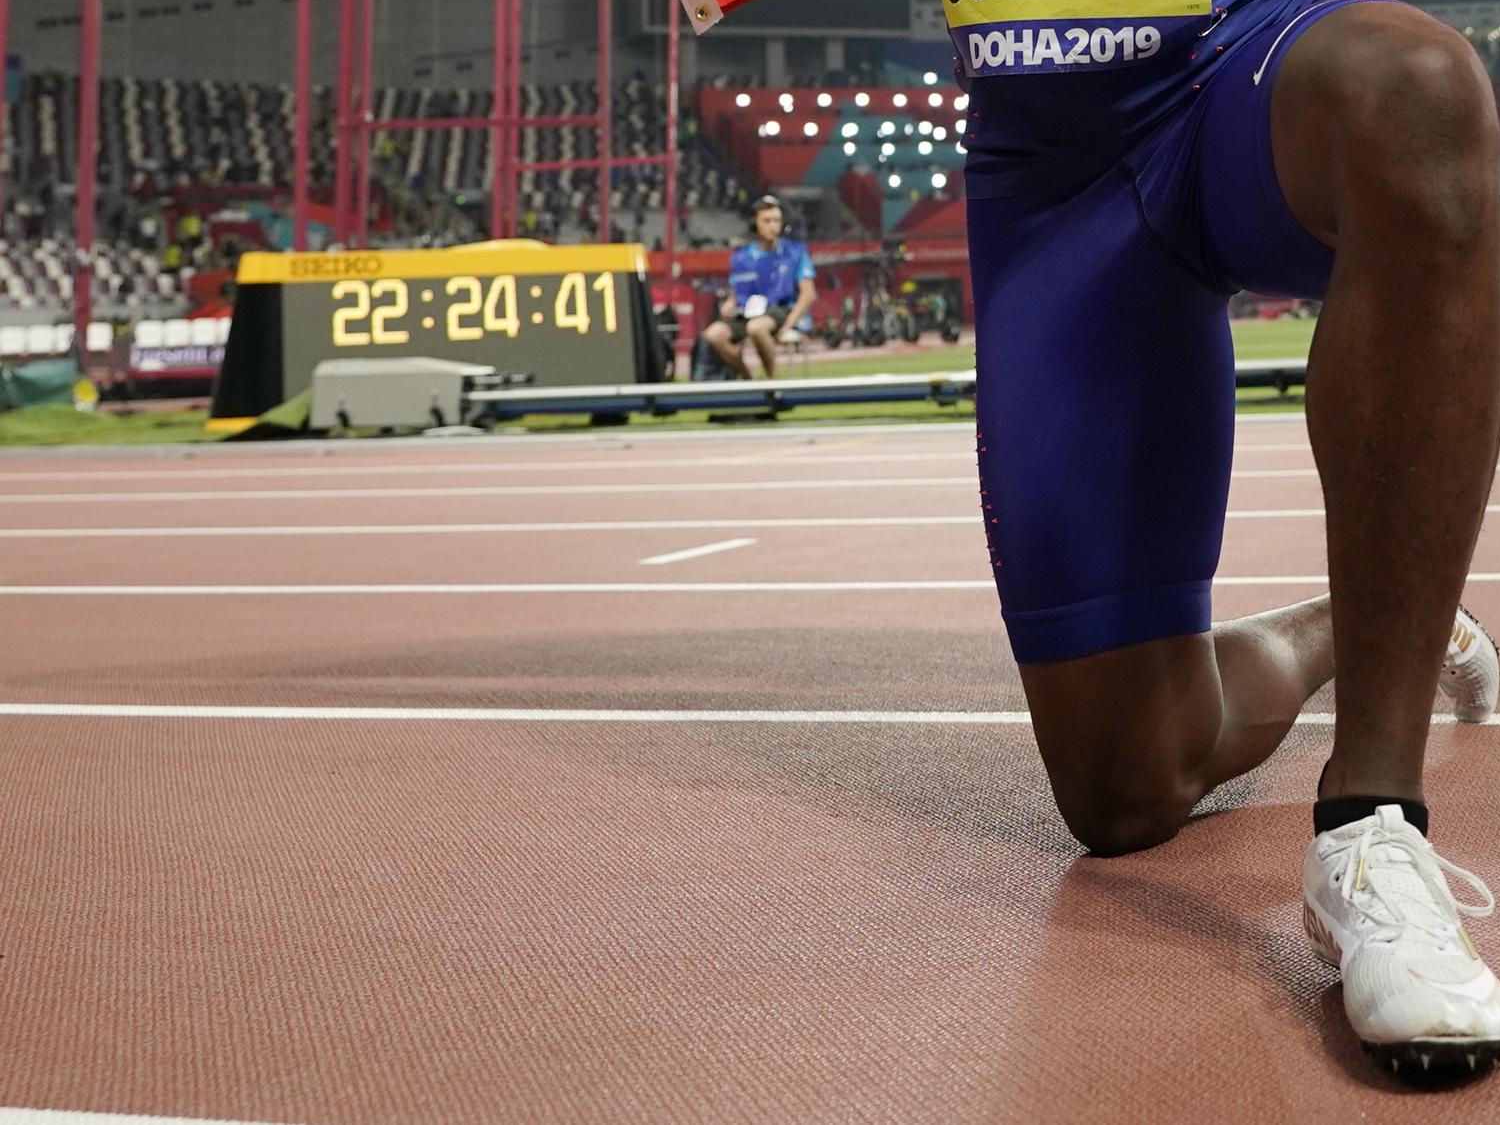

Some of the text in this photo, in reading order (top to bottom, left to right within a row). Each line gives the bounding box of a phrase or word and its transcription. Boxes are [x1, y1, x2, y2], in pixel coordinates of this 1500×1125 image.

[968, 25, 1161, 67] DOHA2019
[291, 256, 384, 276] SEIKO
[331, 271, 617, 347] 22:24:41
